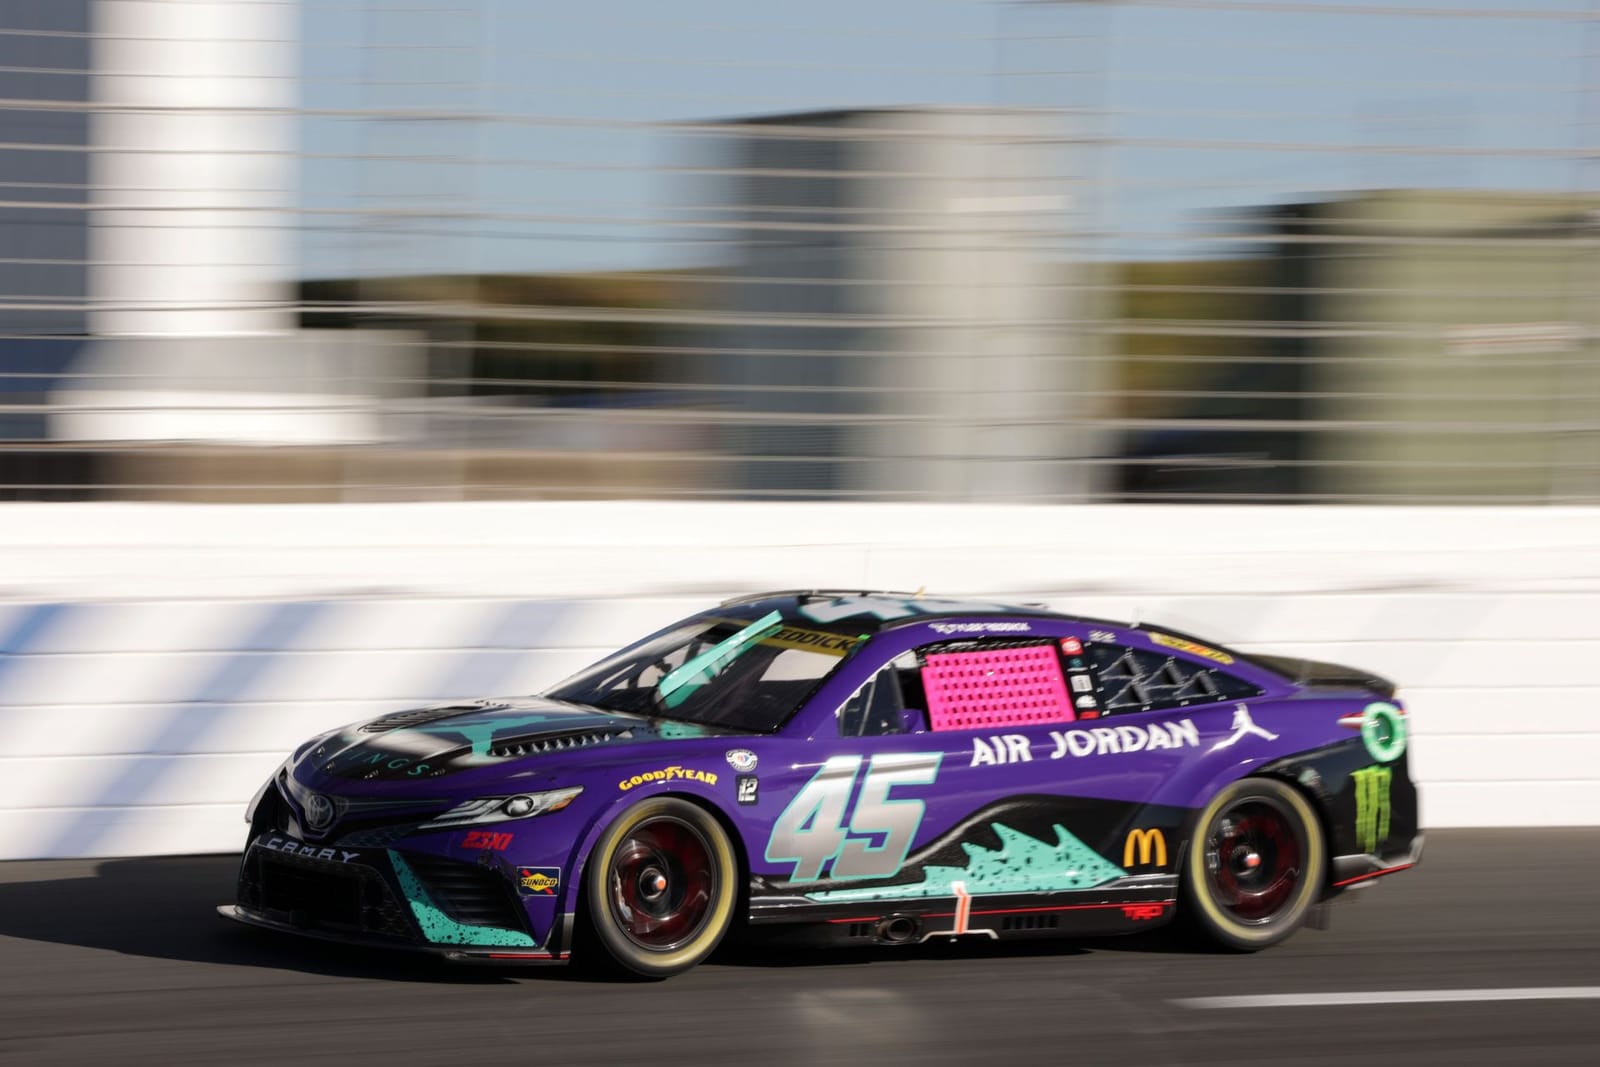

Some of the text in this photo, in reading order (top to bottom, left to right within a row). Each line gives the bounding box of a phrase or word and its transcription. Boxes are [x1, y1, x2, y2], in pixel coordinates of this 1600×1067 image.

[774, 628, 857, 651] EDDICK
[970, 718, 1200, 767] AIR JORDAN
[619, 765, 718, 792] GOODYEAR
[738, 778, 758, 802] 12
[764, 751, 944, 884] 45
[461, 831, 514, 851] 23XI
[520, 877, 558, 887] SUNOCO
[1120, 905, 1163, 921] TRD
